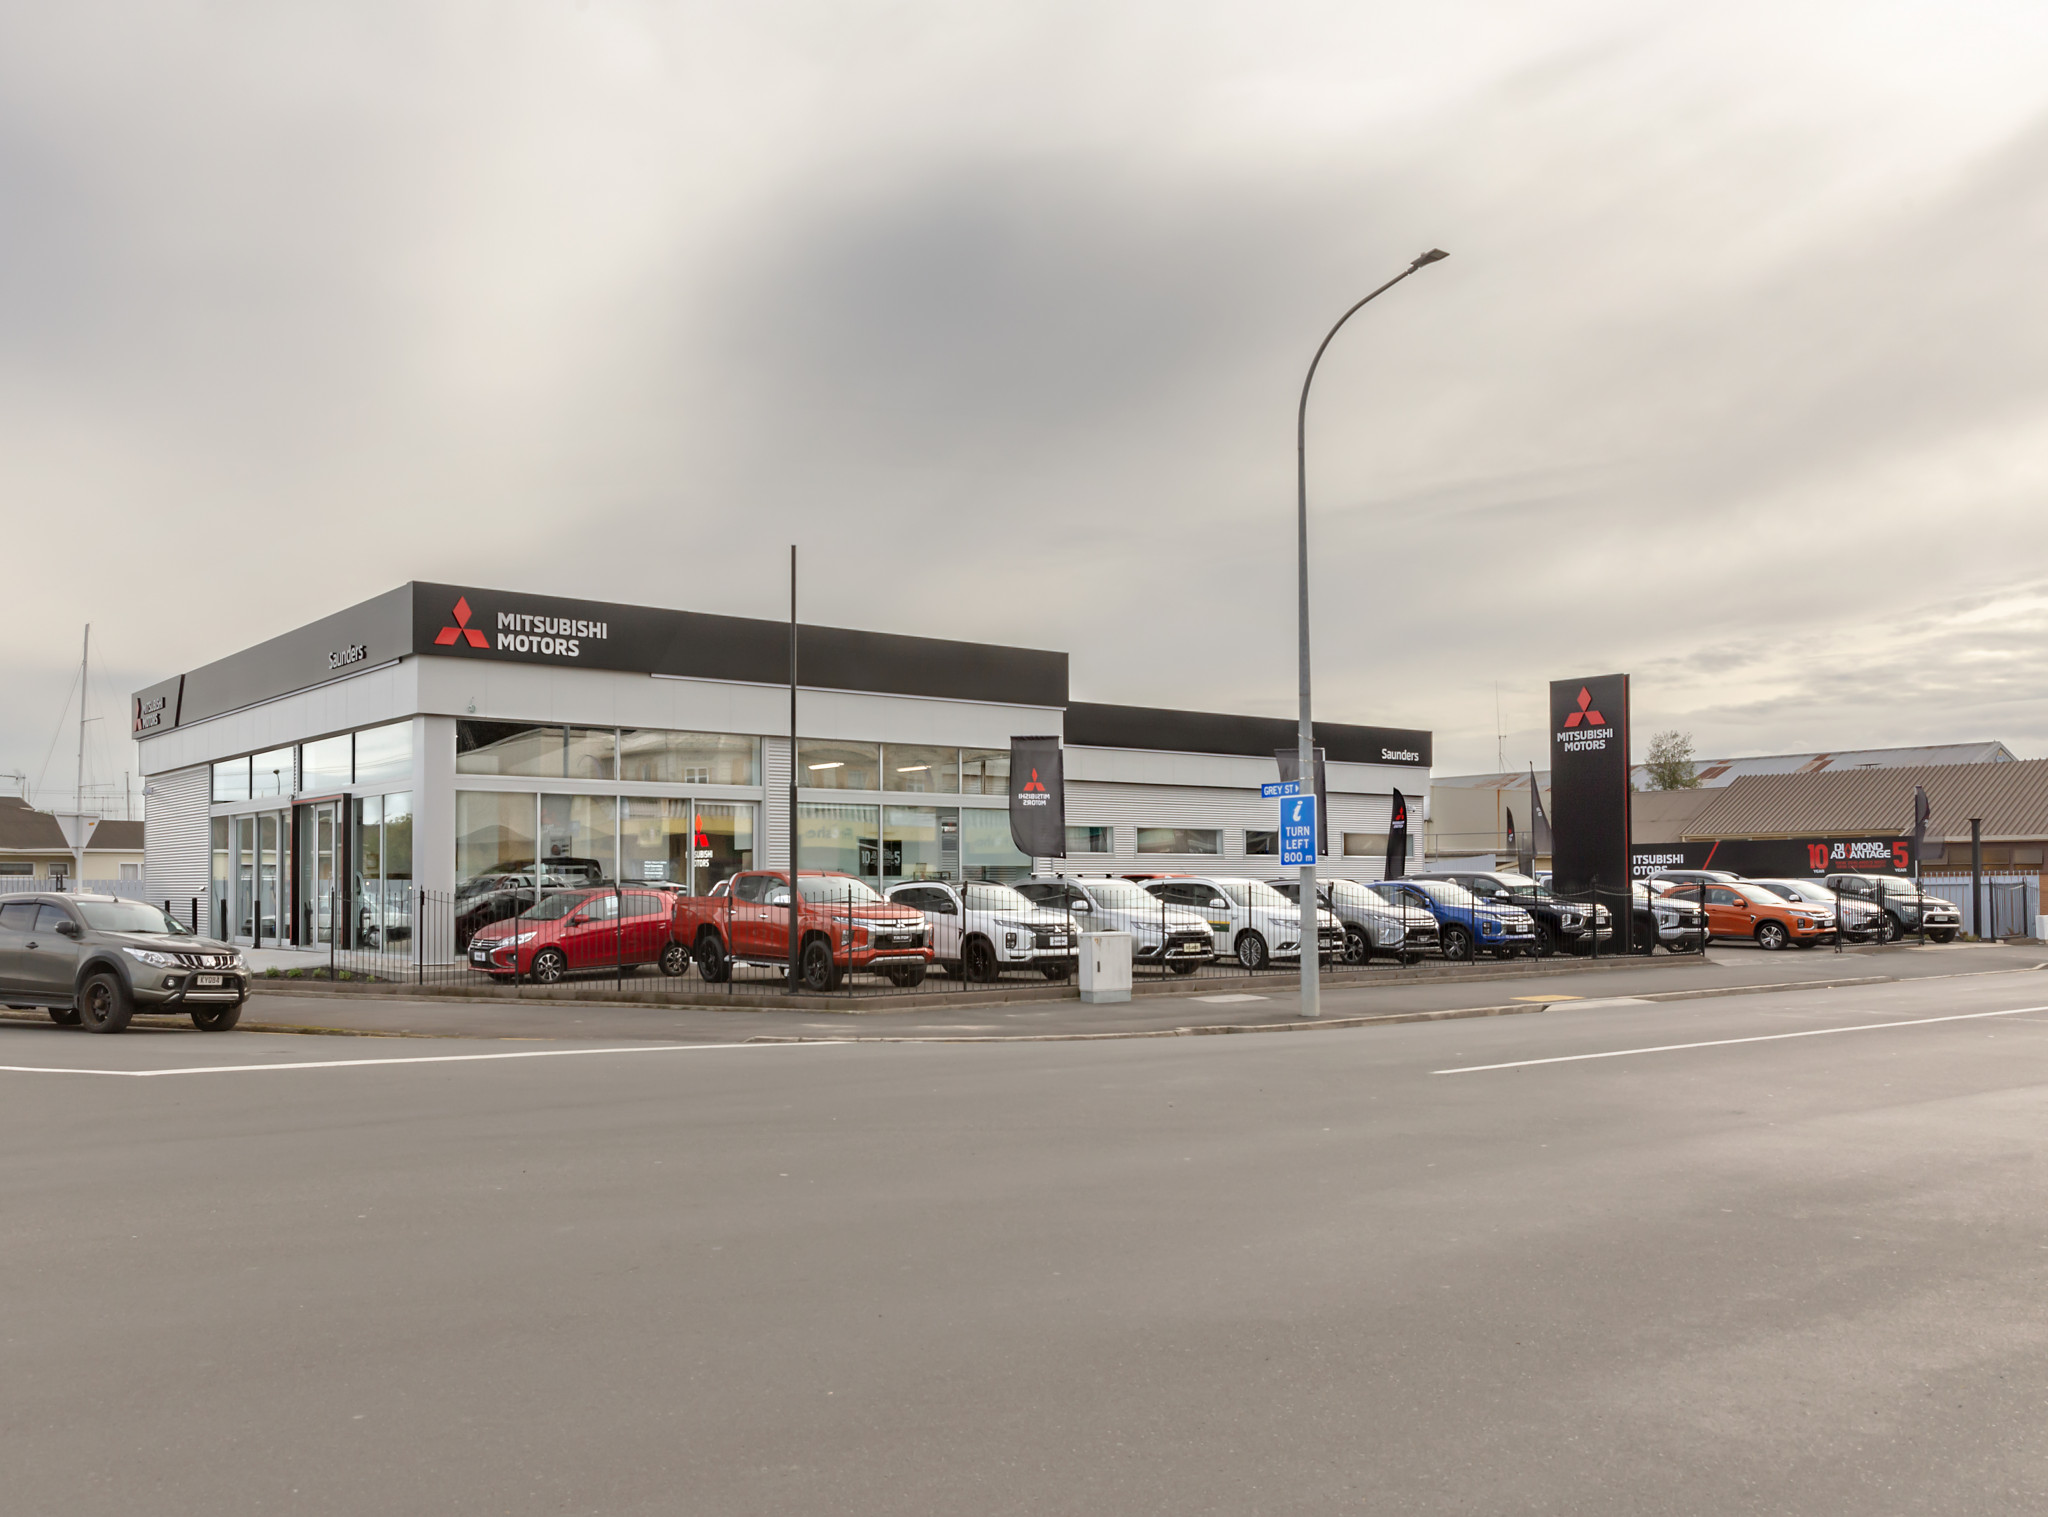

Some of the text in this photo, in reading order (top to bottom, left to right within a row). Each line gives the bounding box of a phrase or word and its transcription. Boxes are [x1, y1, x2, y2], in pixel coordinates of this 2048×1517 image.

[497, 612, 608, 640] MITSUBISHI
[497, 633, 580, 657] MOTORS
[328, 644, 365, 669] Saunders
[1556, 728, 1613, 742] MITSUBISHI
[1564, 740, 1606, 752] MOTORS
[1381, 748, 1419, 761] Saunders
[1263, 784, 1294, 796] GREY ST
[1285, 826, 1310, 837] TURN
[1286, 839, 1309, 850] LEFT
[861, 850, 871, 865] 10
[894, 850, 901, 865] 5
[1284, 852, 1303, 863] 800
[1632, 854, 1684, 865] ITSUBISHI
[1807, 843, 1829, 870] 10
[1892, 841, 1909, 868] 5
